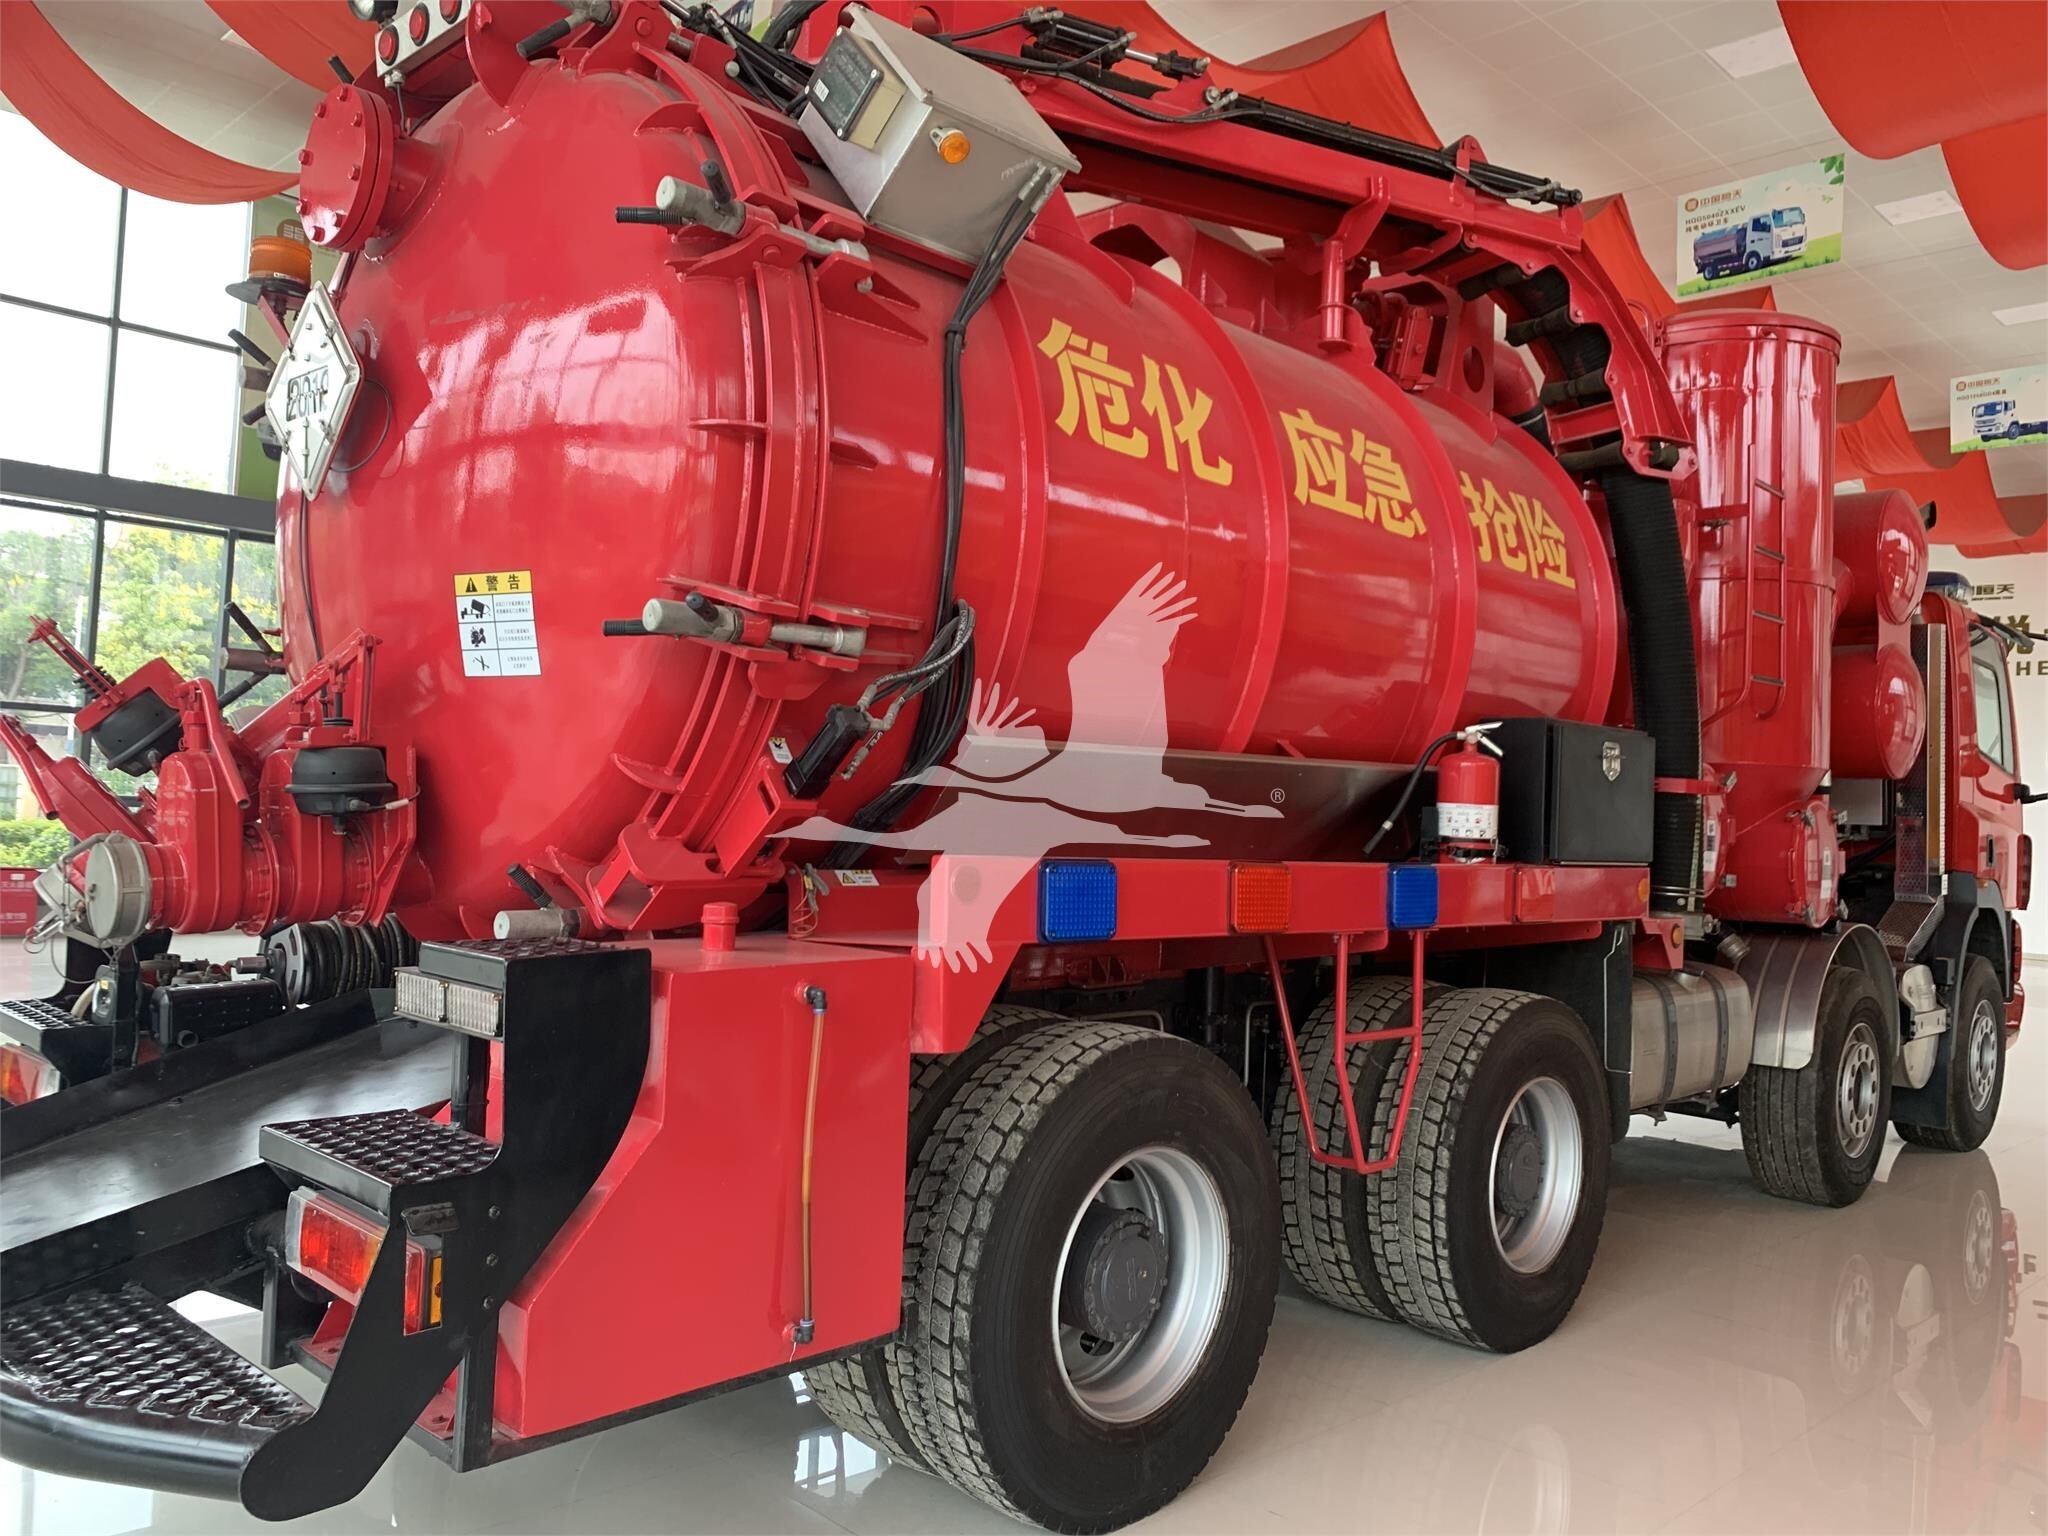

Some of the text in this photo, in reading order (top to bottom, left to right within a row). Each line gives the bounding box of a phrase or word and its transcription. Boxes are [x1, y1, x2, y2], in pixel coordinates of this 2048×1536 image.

[1037, 317, 1576, 590] 危化 应急 抢险
[486, 573, 520, 592] 警告
[1971, 583, 2015, 596] 恒天
